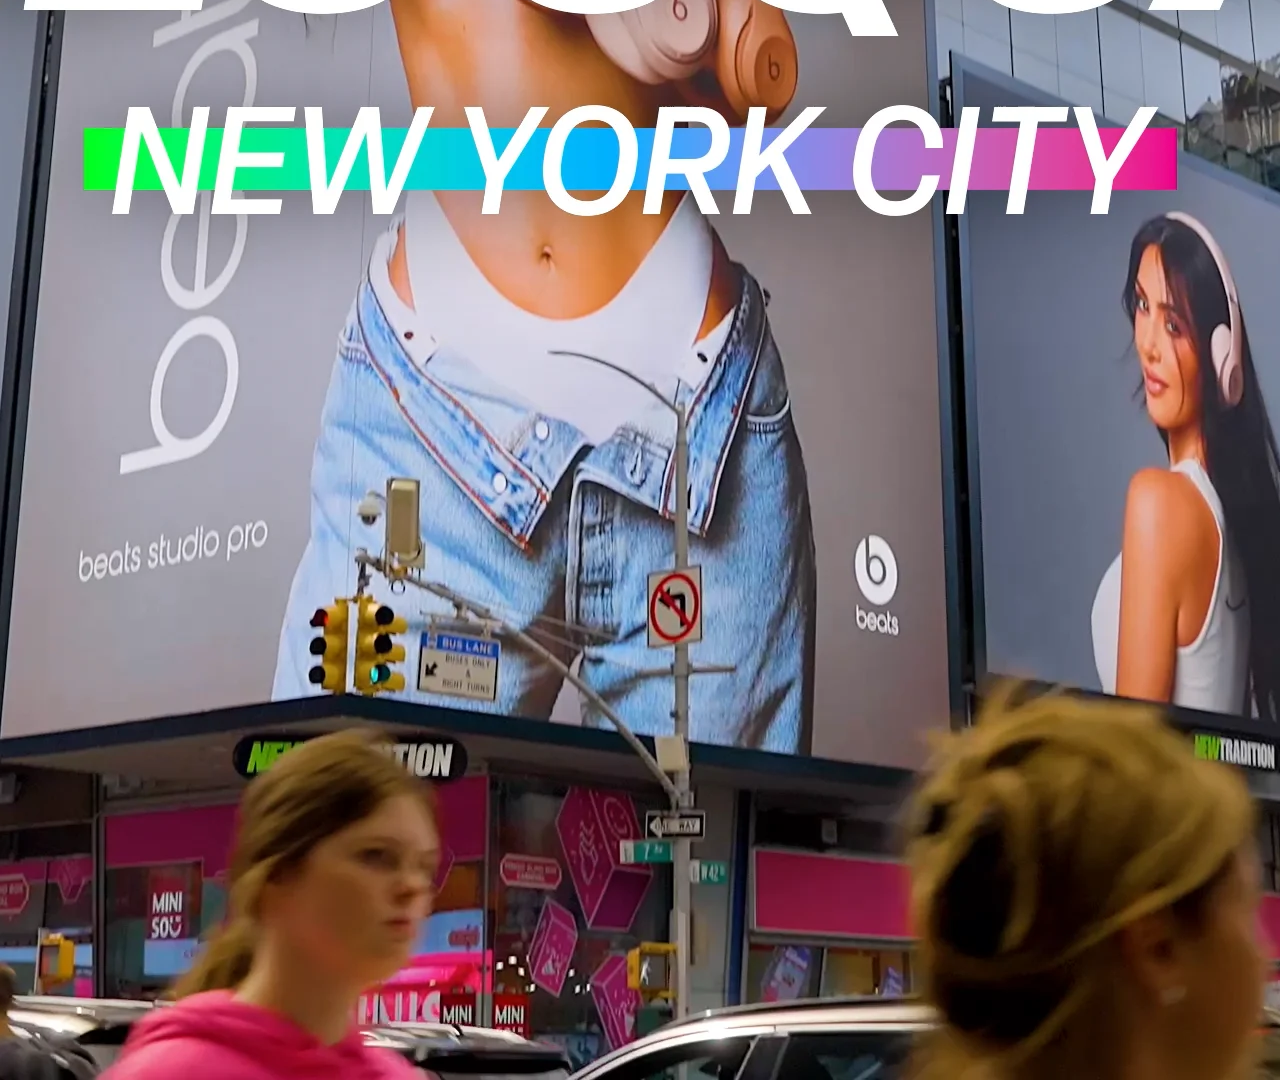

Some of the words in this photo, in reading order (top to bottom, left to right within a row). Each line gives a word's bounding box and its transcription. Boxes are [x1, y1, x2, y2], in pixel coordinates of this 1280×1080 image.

[79, 541, 141, 582] beats
[148, 525, 220, 568] studio
[227, 520, 268, 561] pro
[856, 604, 899, 636] beats
[442, 637, 463, 651] BUS
[466, 640, 491, 654] LANE
[472, 658, 490, 668] ONLY
[442, 679, 462, 689] RIGHT
[467, 682, 490, 694] TURNS
[644, 843, 650, 860] 7
[152, 891, 183, 914] MINI
[443, 1005, 473, 1024] MINI
[495, 1005, 524, 1024] MINI
